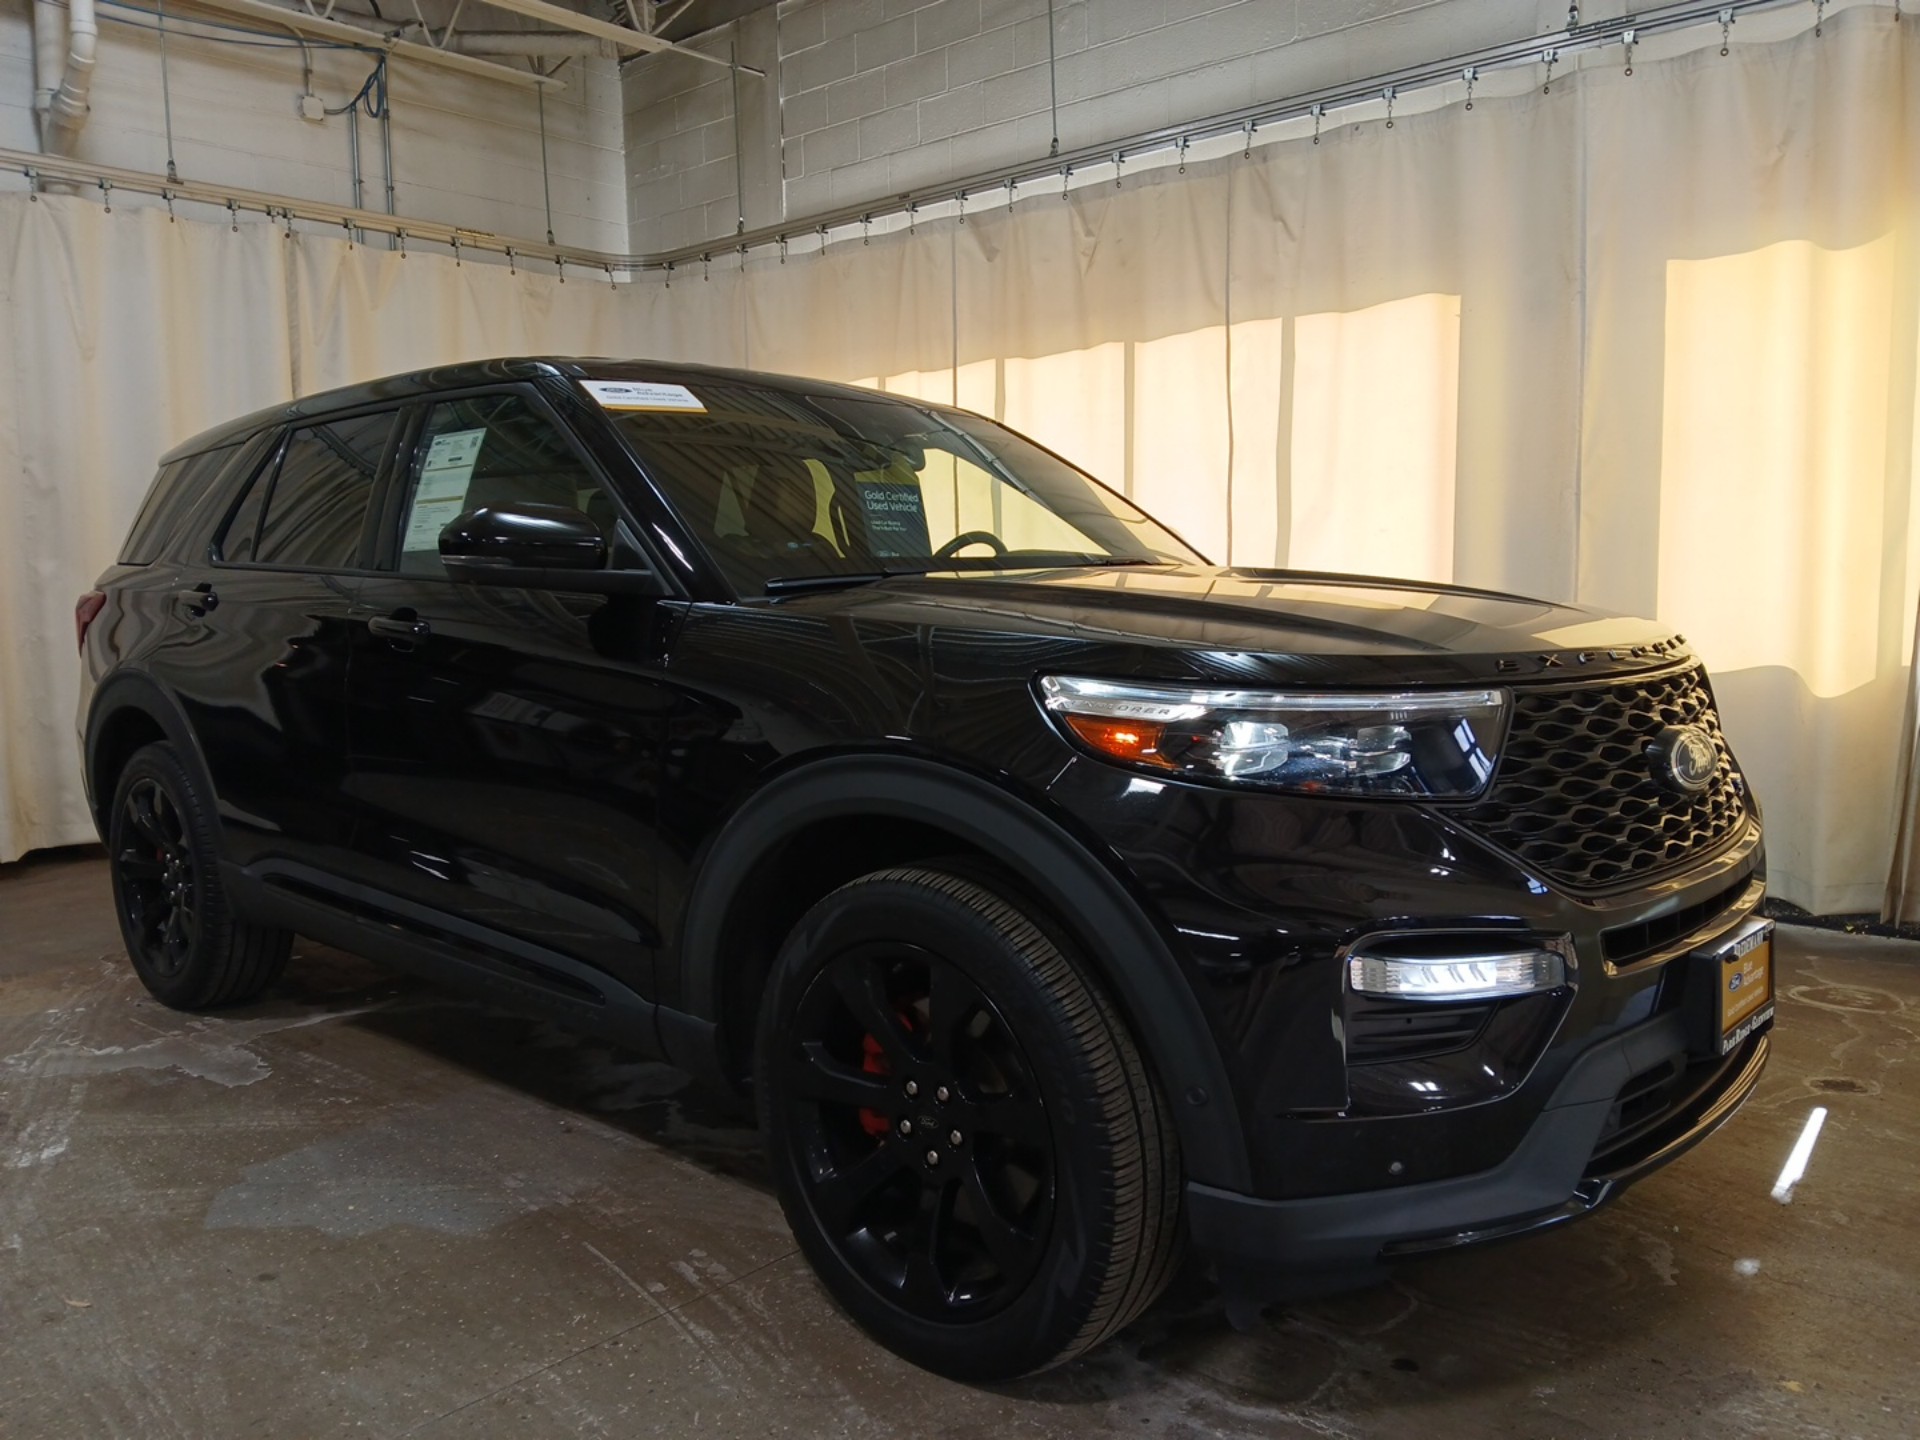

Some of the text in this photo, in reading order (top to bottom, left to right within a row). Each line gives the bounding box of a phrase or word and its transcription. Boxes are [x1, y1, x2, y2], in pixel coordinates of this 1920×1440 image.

[864, 490, 919, 503] Gold Certified
[866, 500, 918, 512] Used Vehicle
